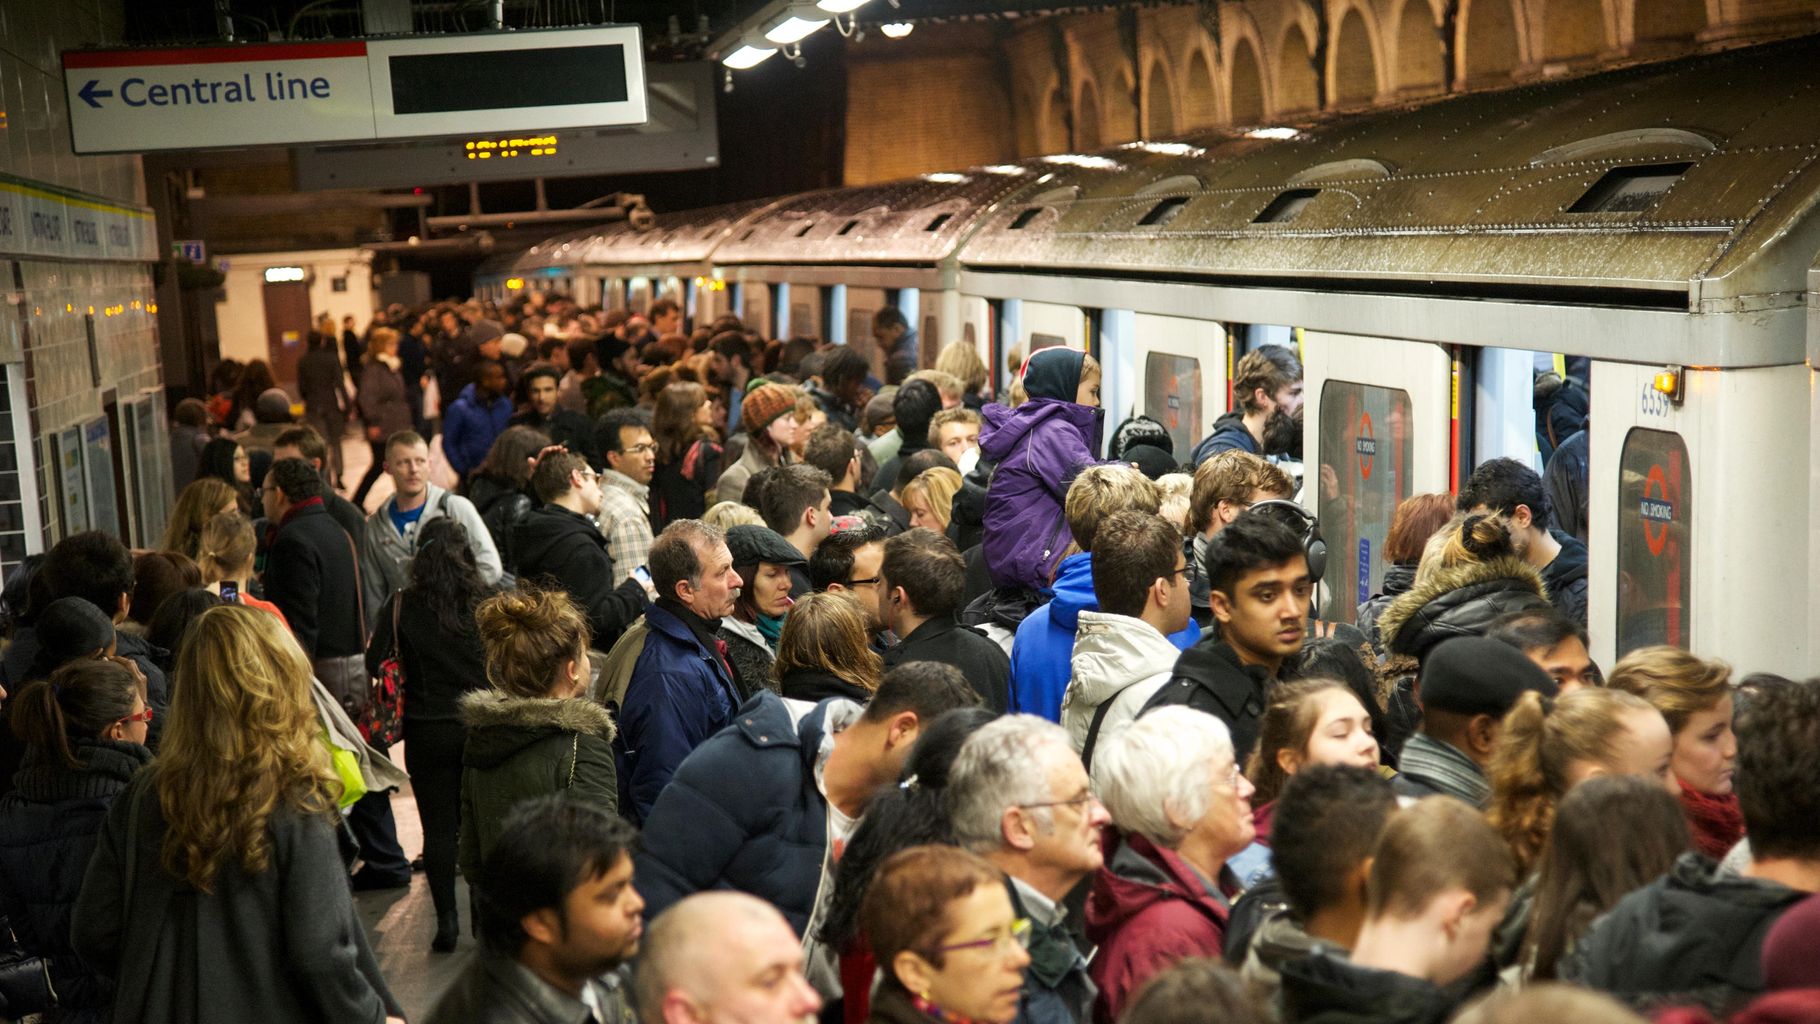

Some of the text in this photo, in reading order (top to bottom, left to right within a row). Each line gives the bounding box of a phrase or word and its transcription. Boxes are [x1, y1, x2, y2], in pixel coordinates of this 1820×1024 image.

[120, 72, 330, 107] Central line
[1640, 501, 1671, 520] NO SMOKING
